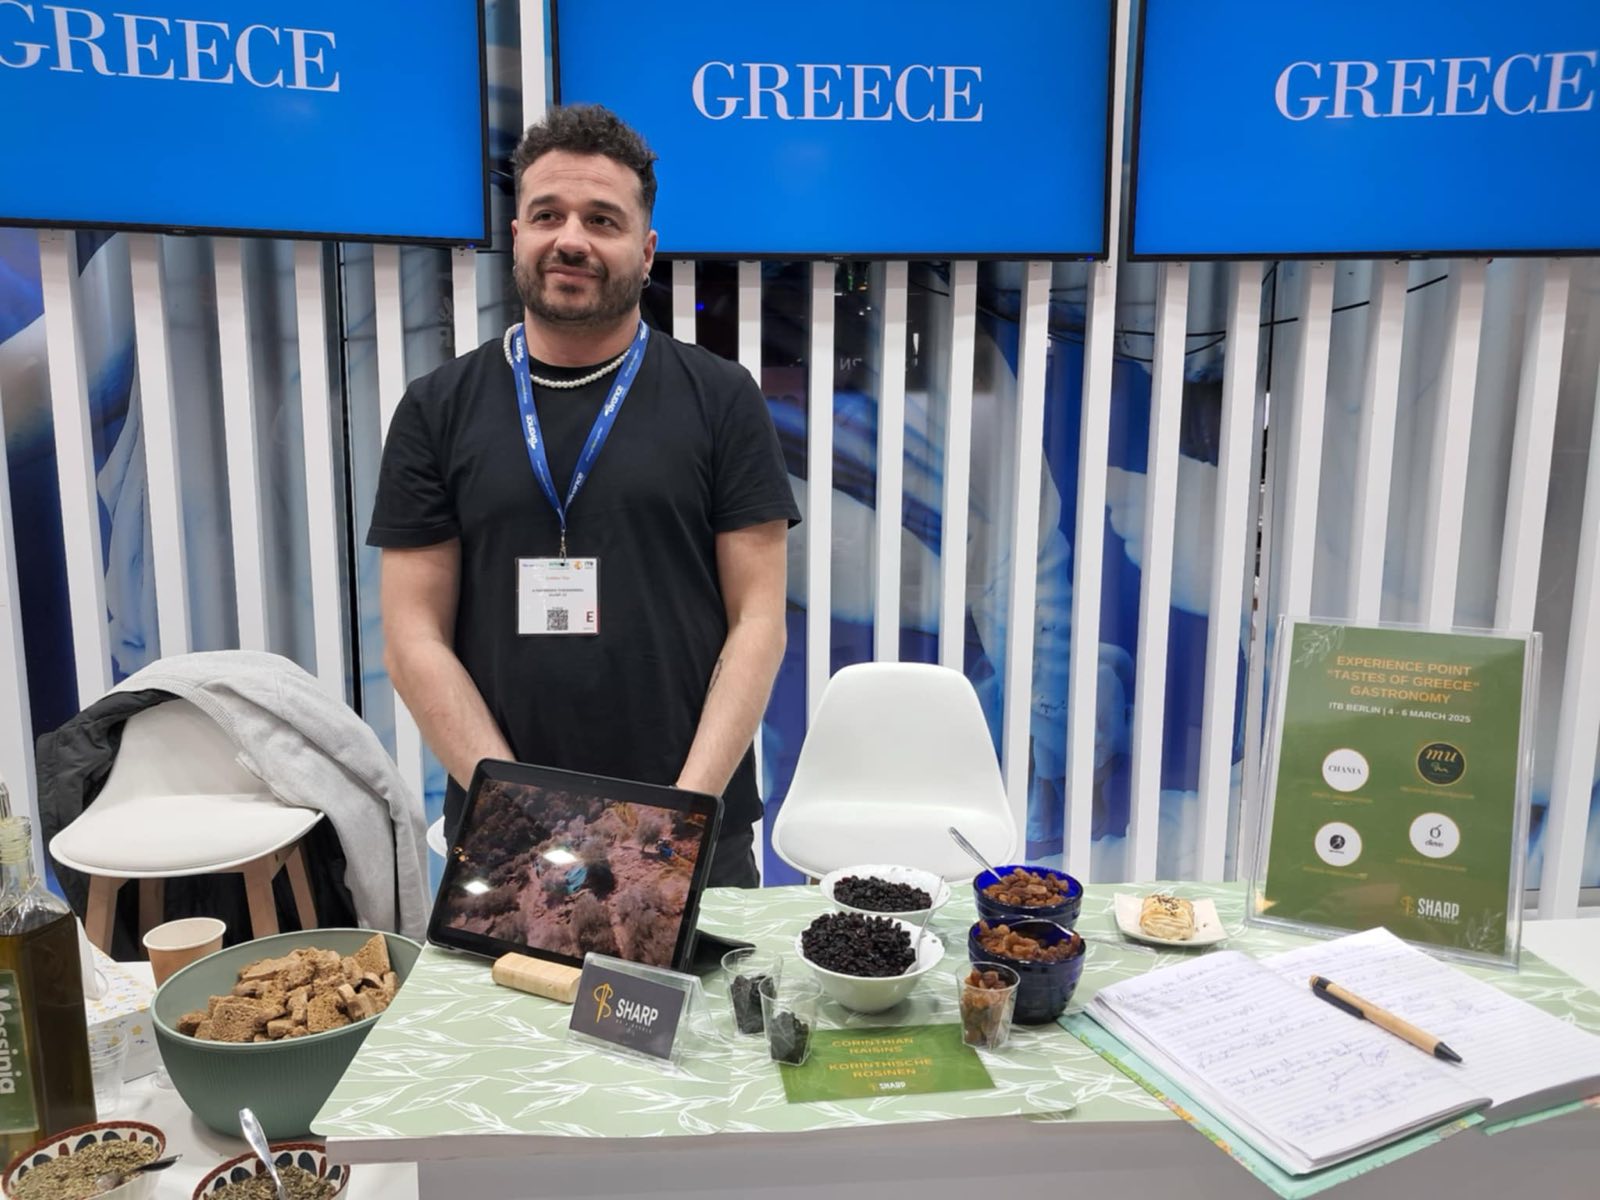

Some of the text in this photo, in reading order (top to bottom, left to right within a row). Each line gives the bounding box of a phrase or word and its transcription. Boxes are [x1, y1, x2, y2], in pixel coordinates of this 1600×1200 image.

[0, 1, 340, 92] GREECE
[692, 61, 983, 122] GREECE
[1274, 50, 1598, 121] GREECE
[586, 610, 595, 623] E
[1337, 655, 1473, 676] EXPERIENCE POINT
[1389, 674, 1410, 685] OF
[1349, 685, 1451, 704] GASTRONOMY
[1328, 701, 1344, 711] ITB
[1345, 703, 1381, 715] BERLIN
[1387, 707, 1394, 715] 4
[1401, 709, 1408, 717] 6
[1408, 710, 1446, 721] MARCH
[1448, 713, 1472, 724] 2025
[1417, 897, 1460, 920] SHARP
[615, 998, 659, 1027] SHARP
[831, 1037, 914, 1048] CORINTHIAN
[849, 1046, 904, 1055] RAISINS
[828, 1058, 933, 1071] KORINTHISCHE
[852, 1067, 917, 1078] ROSINEN
